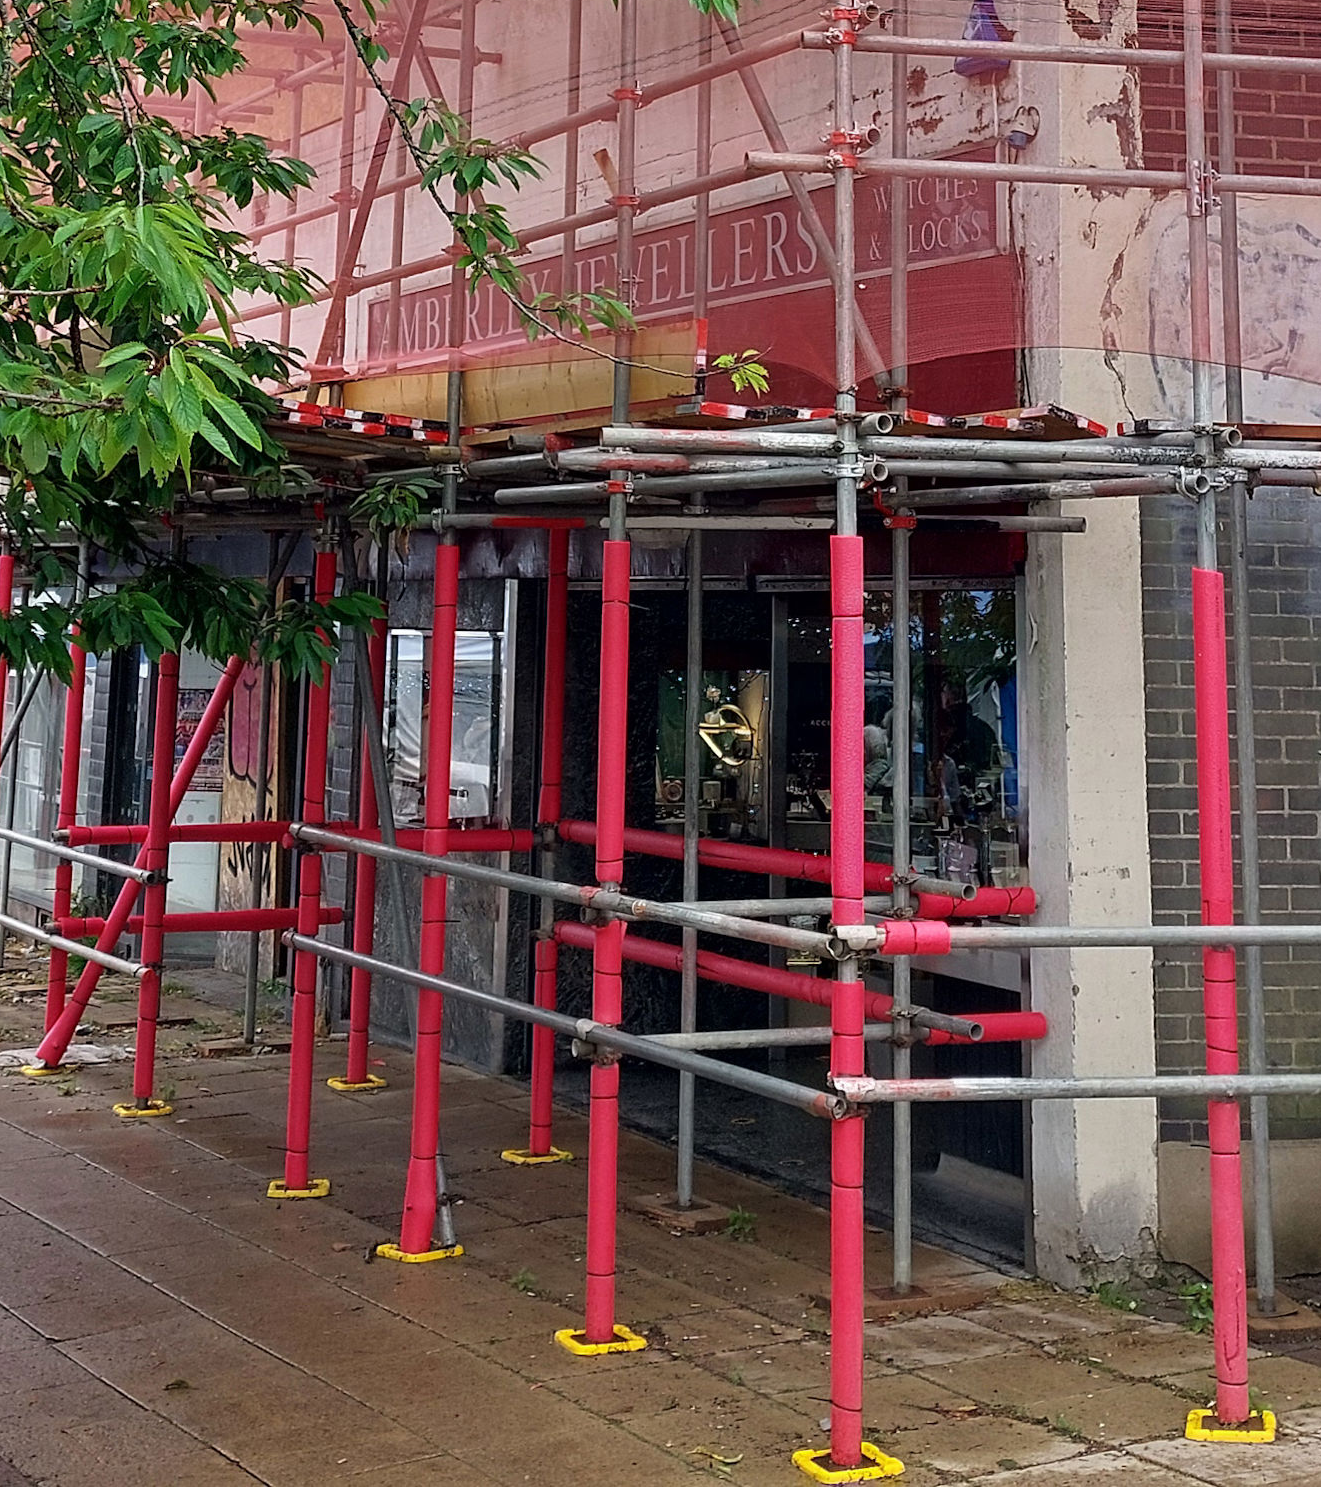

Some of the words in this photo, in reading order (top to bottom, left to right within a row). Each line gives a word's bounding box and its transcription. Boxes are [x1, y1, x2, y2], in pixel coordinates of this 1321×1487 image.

[872, 176, 979, 213] WTCHES
[869, 233, 883, 261] &
[907, 210, 982, 254] LOCKS
